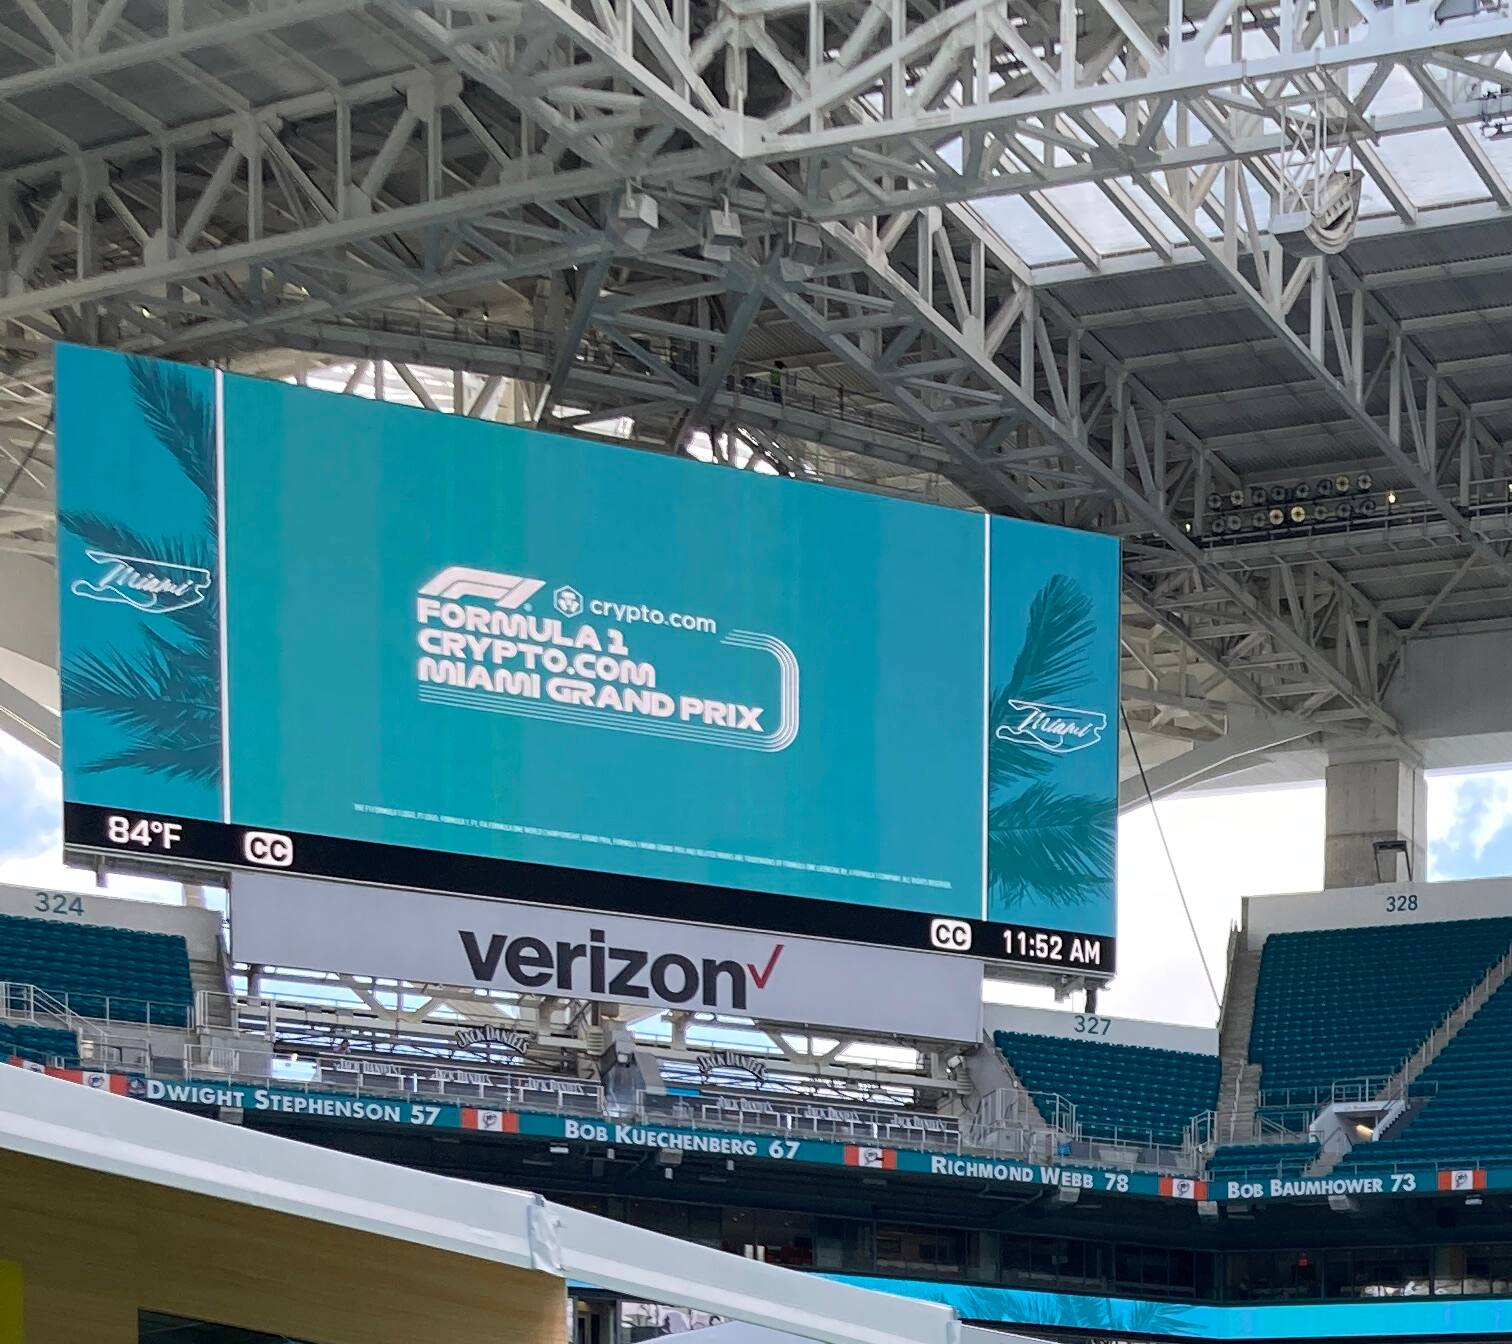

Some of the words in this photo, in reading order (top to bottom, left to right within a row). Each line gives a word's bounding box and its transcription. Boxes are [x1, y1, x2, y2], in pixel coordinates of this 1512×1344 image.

[417, 598, 602, 652] FORMULA
[607, 628, 629, 656] 1
[590, 599, 717, 634] crypto.com
[418, 628, 656, 688] CRYPTO.COM
[418, 657, 541, 699] MIAMI
[547, 678, 676, 719] GRAND
[681, 696, 765, 732] PRIX
[108, 815, 182, 850] 84°F
[250, 835, 289, 863] CC
[35, 892, 84, 916] 324
[1386, 895, 1418, 912] 328
[935, 923, 967, 947] CC
[1003, 929, 1063, 961] 11:52
[1070, 938, 1100, 964] AM
[458, 930, 748, 1009] verizon
[1073, 1015, 1112, 1036] 327
[147, 1078, 245, 1109] DWIGHT
[254, 1088, 400, 1123] STEPHENSON
[410, 1105, 441, 1127] 57
[564, 1118, 608, 1143] BOB
[614, 1123, 757, 1157] KUECHENBERG
[768, 1141, 800, 1160] 67
[931, 1156, 1034, 1184] RICHMOND
[1040, 1167, 1094, 1190] WEBB
[1104, 1172, 1129, 1193] 78
[1227, 1181, 1264, 1199] BOB
[1271, 1175, 1383, 1198] BAUMHOWER
[1391, 1173, 1417, 1193] 73
